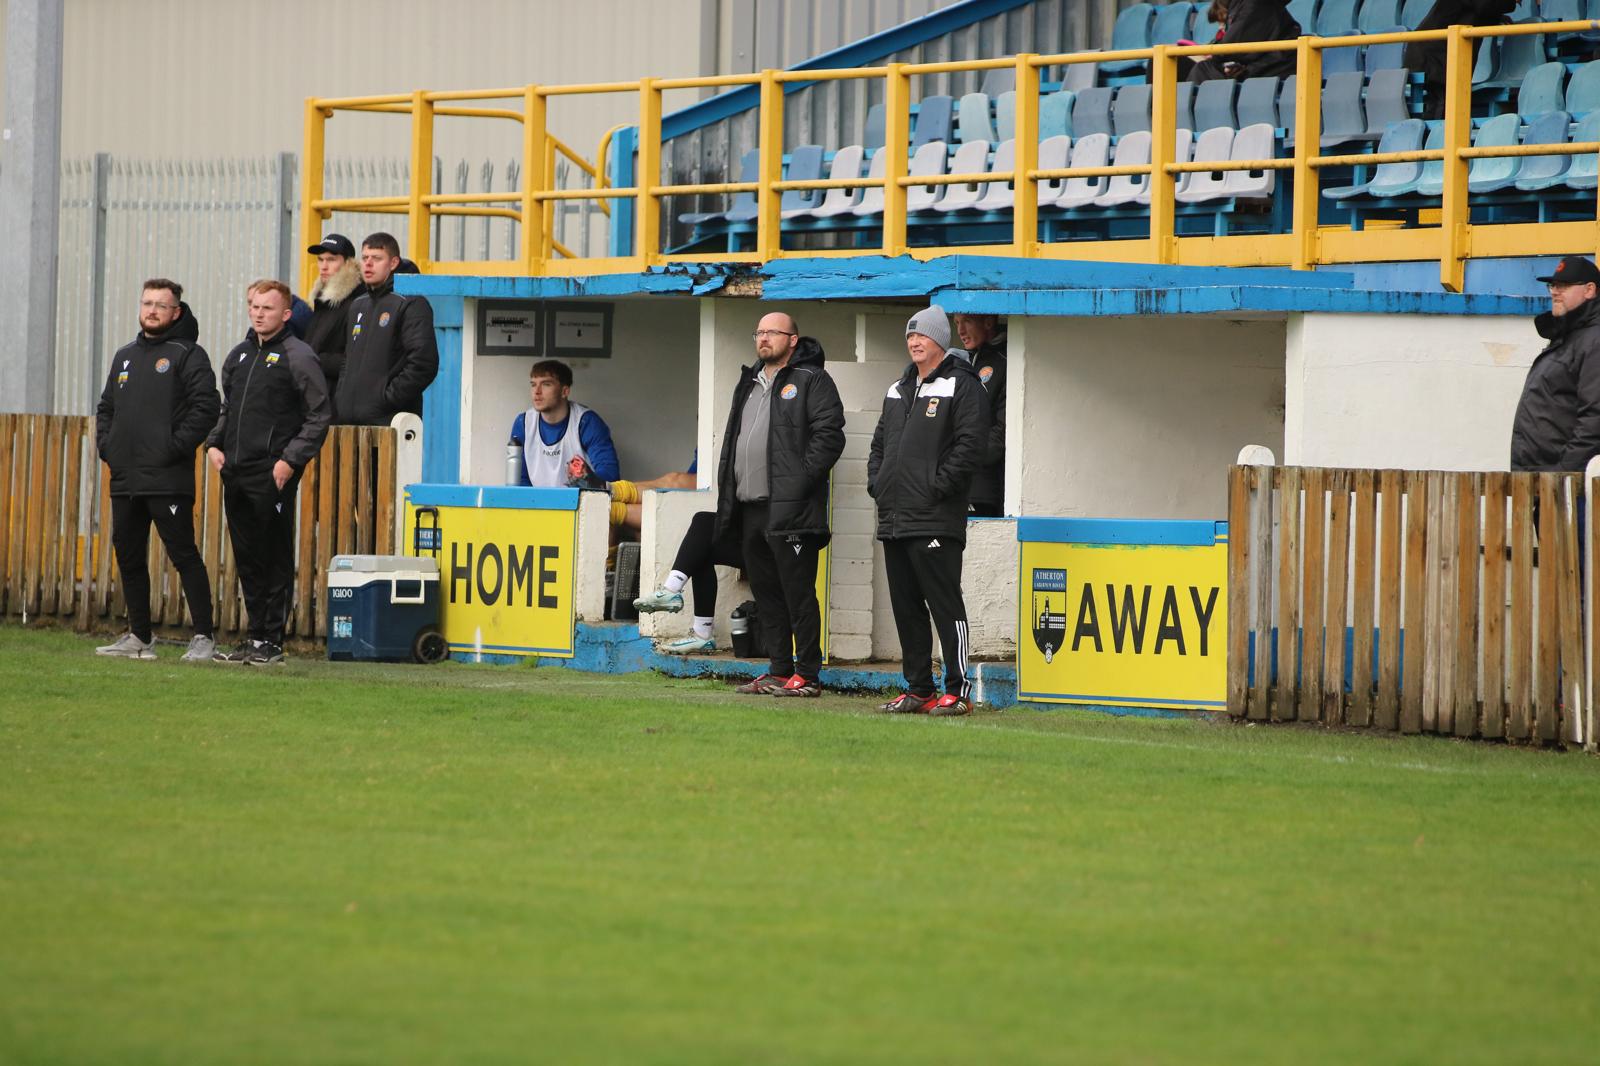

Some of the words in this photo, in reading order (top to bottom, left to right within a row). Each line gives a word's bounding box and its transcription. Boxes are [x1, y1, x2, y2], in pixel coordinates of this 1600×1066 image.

[332, 588, 353, 598] IGLOO
[450, 542, 559, 609] HOME
[1035, 571, 1064, 580] ATHERTON
[1071, 583, 1220, 656] AWAY
